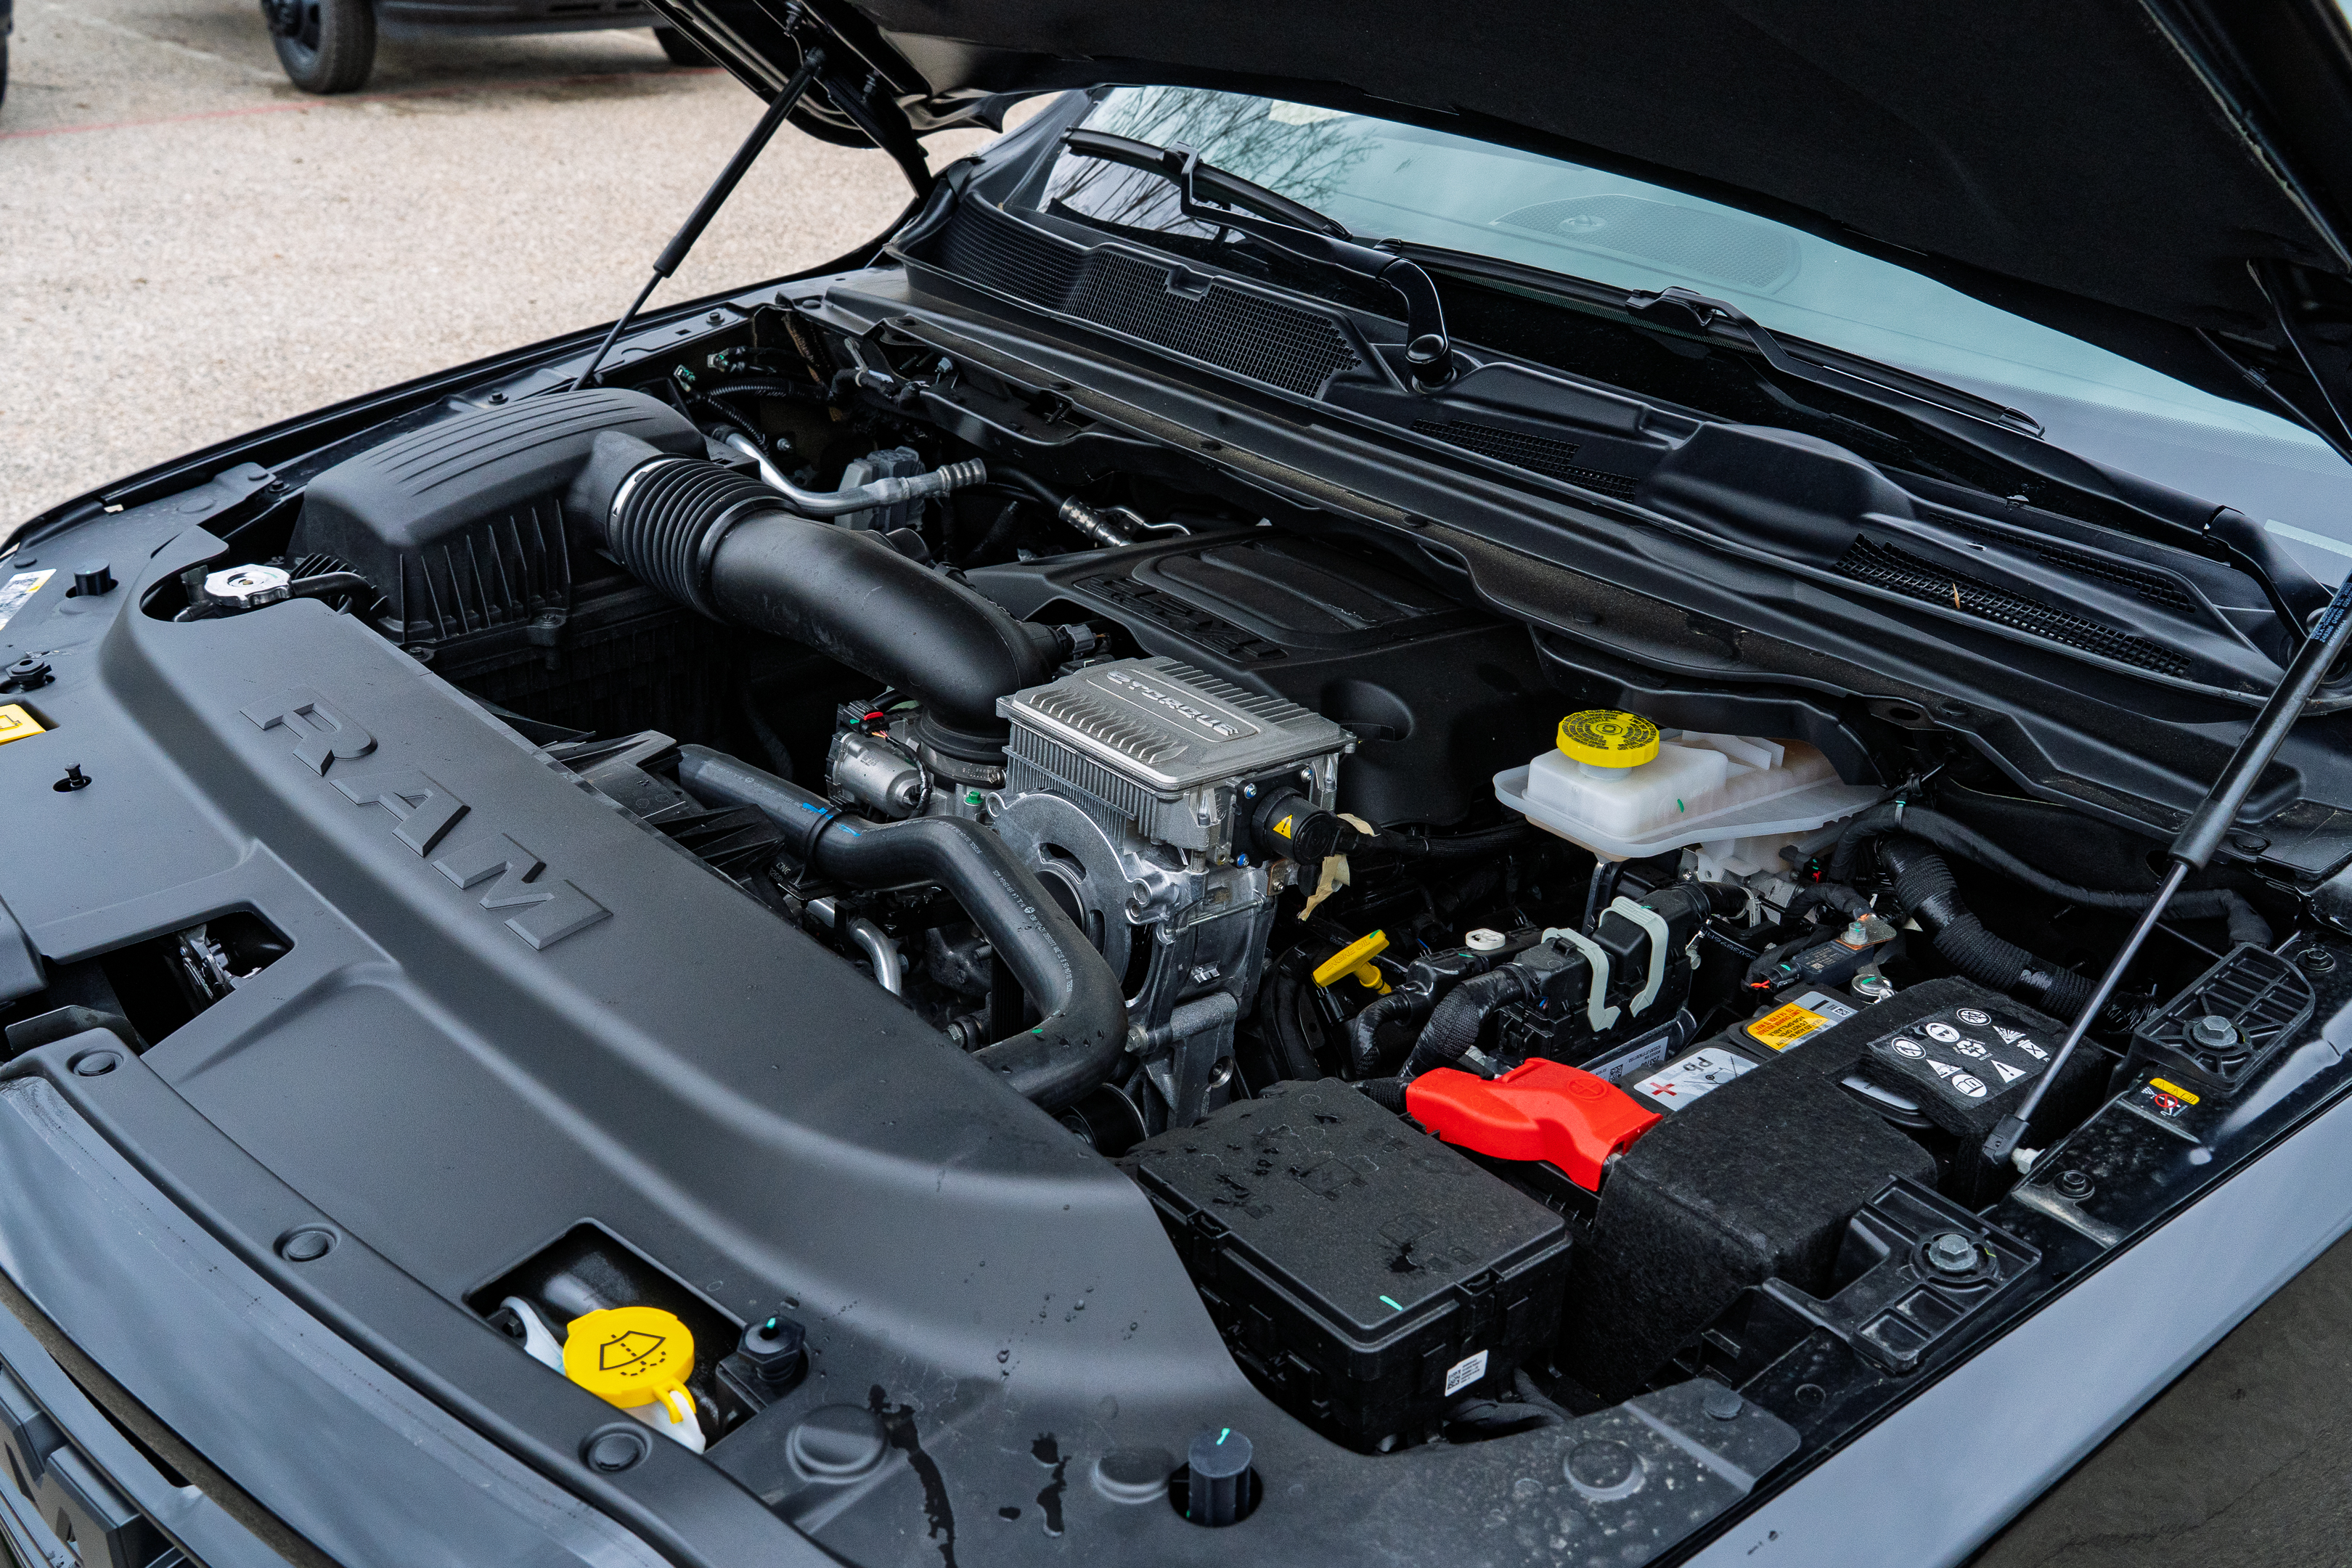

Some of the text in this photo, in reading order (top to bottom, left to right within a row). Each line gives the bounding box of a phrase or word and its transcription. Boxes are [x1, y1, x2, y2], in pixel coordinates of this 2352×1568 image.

[239, 686, 615, 952] RAM
[1324, 947, 1356, 972] ENGINE
[1355, 939, 1371, 951] OIL
[1756, 1009, 1802, 1035] LIMIT CHARGE VOLTAGE
[1768, 1016, 1805, 1037] NON-SPILLABLE
[1805, 1018, 1823, 1030] SEALED
[1795, 1026, 1805, 1035] AGM
[1776, 1032, 1796, 1047] BATTERY
[1682, 1056, 1714, 1072] Pb
[1978, 1053, 1993, 1061] RECYCLE
